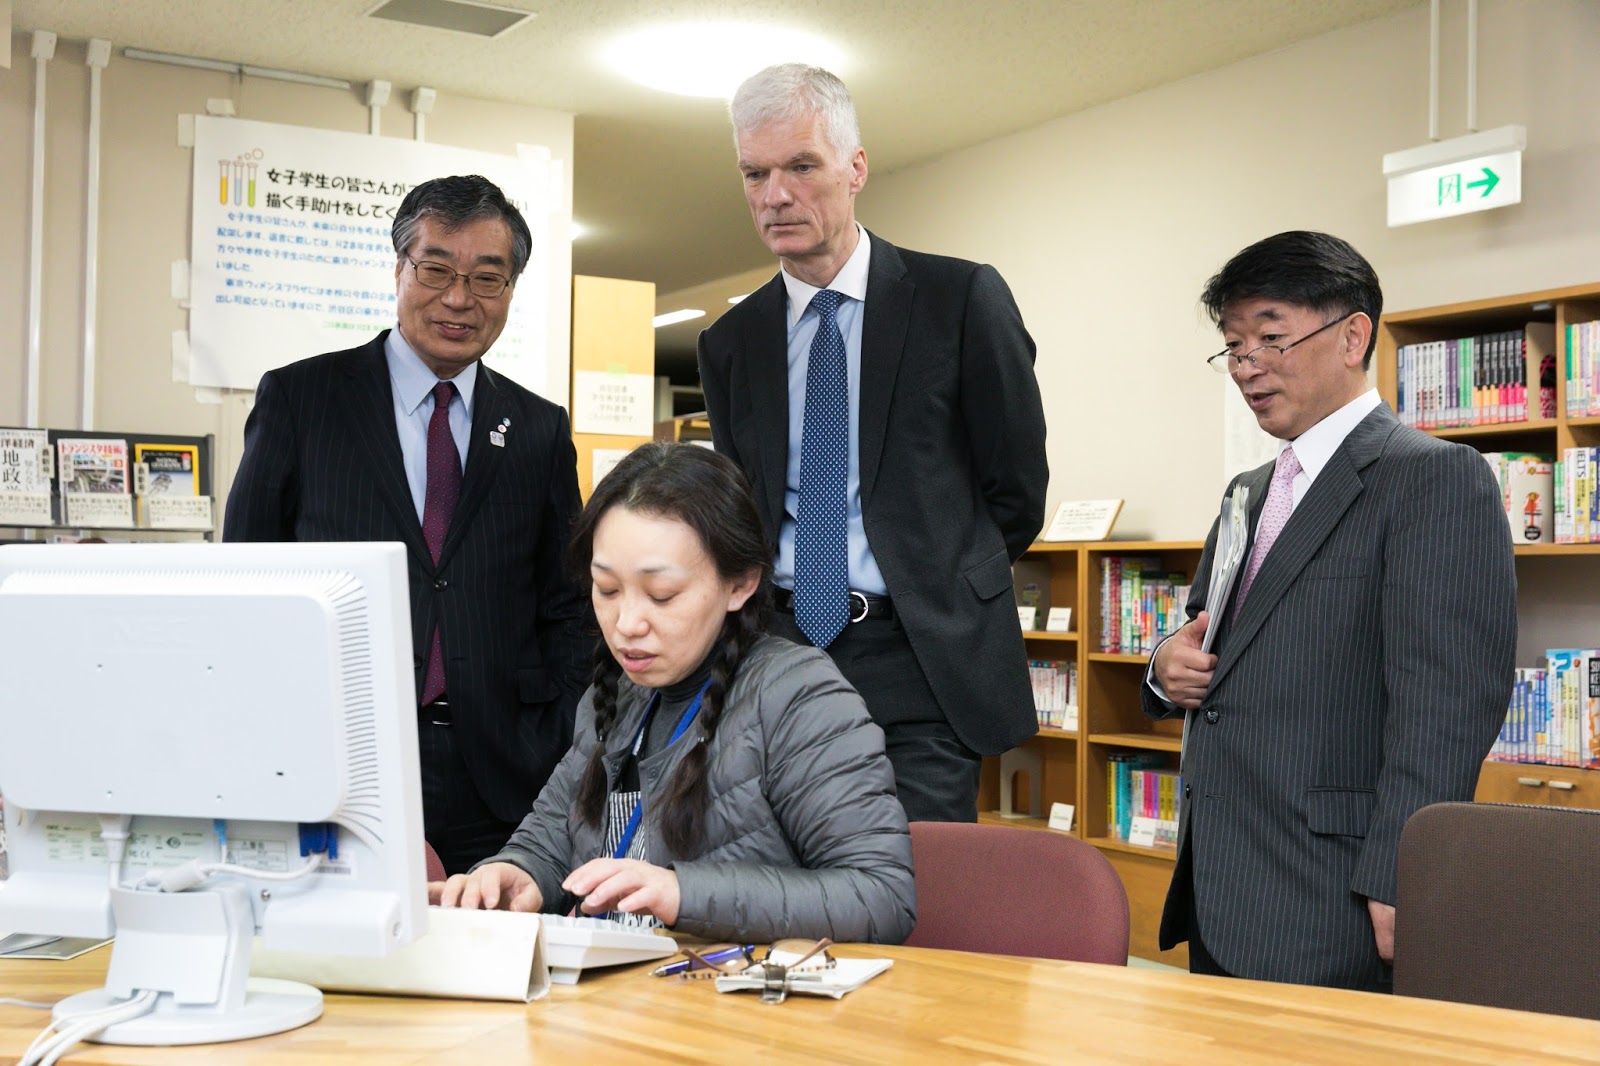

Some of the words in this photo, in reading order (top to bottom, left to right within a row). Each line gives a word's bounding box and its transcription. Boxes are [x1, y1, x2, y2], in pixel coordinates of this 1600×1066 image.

[266, 192, 396, 220] 描く手助けをしてく
[1577, 450, 1586, 478] IELTS
